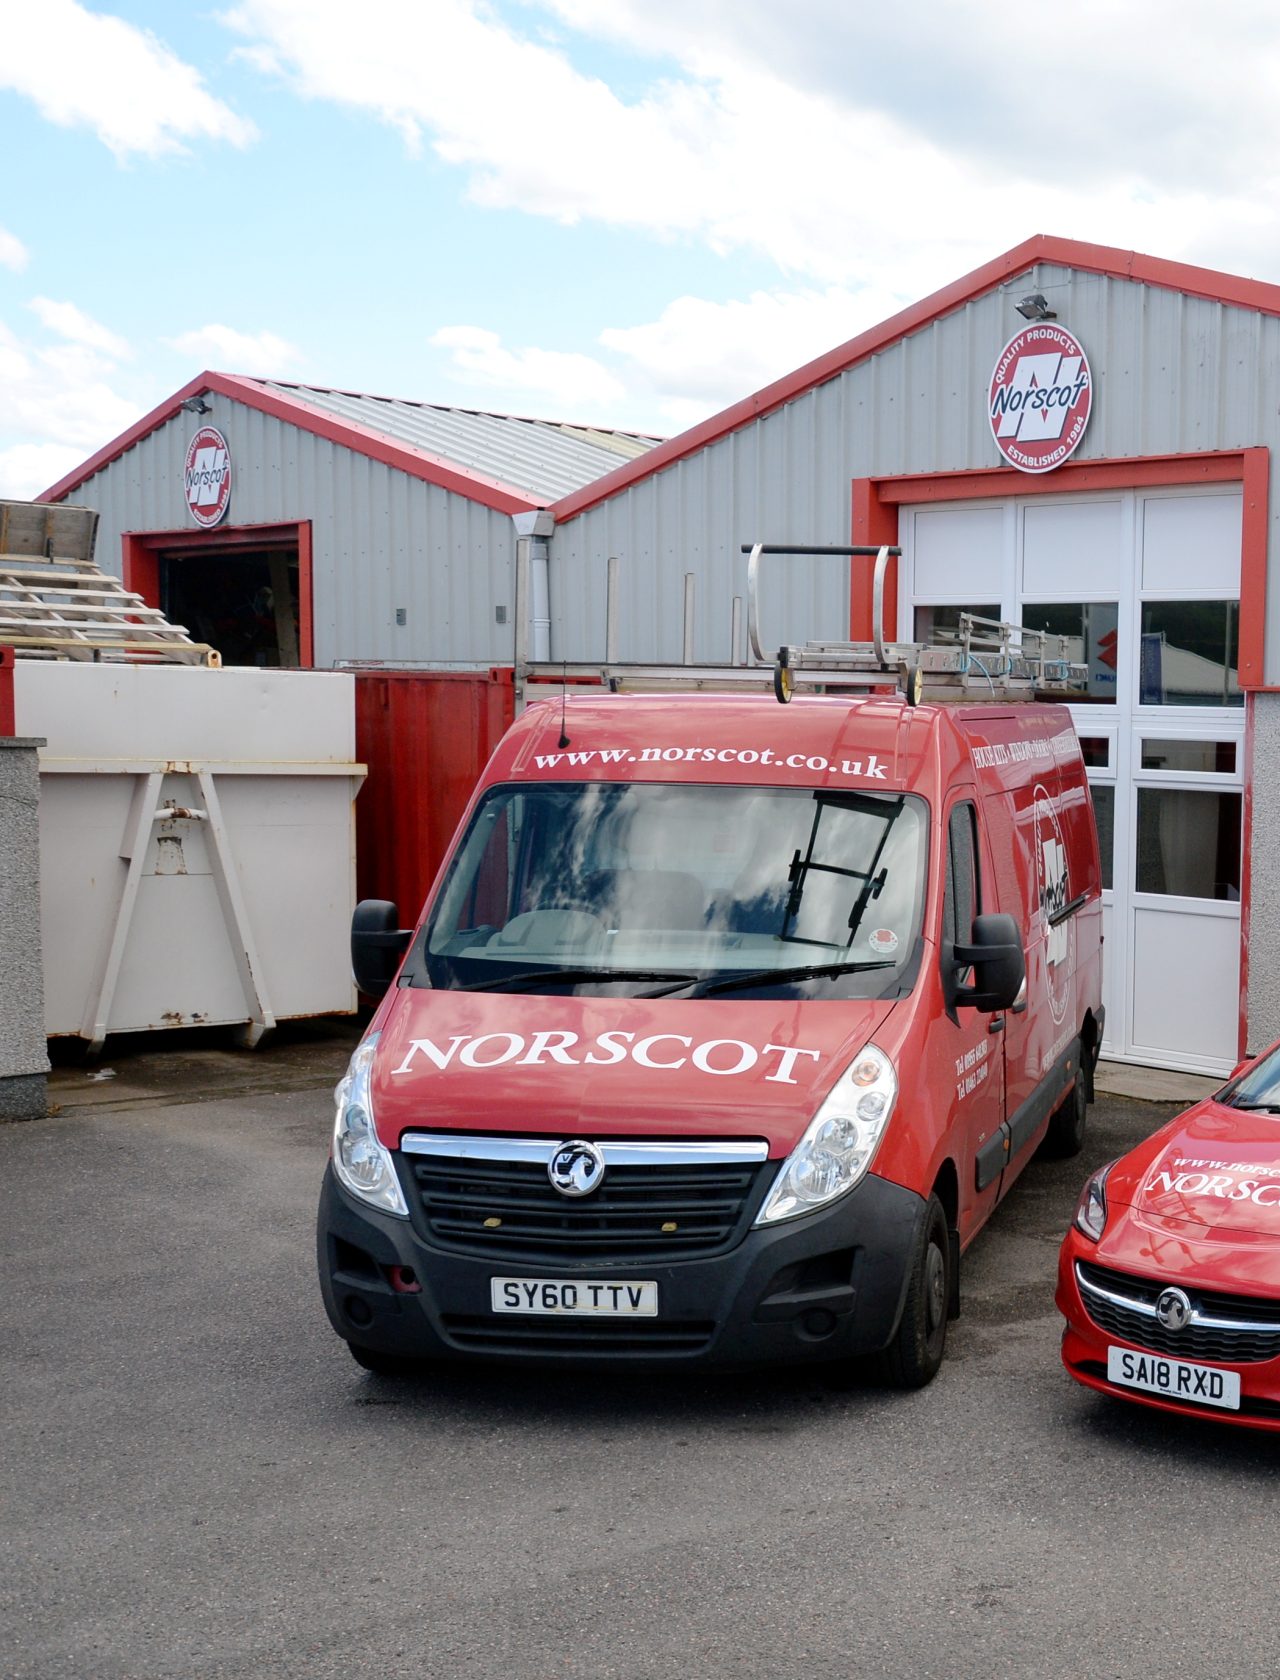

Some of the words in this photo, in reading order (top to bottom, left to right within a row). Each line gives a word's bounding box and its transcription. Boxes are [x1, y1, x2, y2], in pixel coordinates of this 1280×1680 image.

[995, 336, 1025, 384] QUALITY
[1026, 328, 1077, 355] PRODUCTS
[991, 373, 1089, 417] Norscot
[1007, 444, 1067, 467] ESTABLISHED
[1066, 415, 1085, 445] 1984
[186, 460, 229, 488] Norscot
[533, 745, 888, 780] www.norscot.co.uk
[390, 1030, 821, 1085] NORSCOT
[562, 1154, 570, 1162] V
[503, 1282, 578, 1310] SY60
[587, 1285, 643, 1311] TTV
[1122, 1353, 1170, 1388] SA18
[1177, 1365, 1224, 1399] RXD
